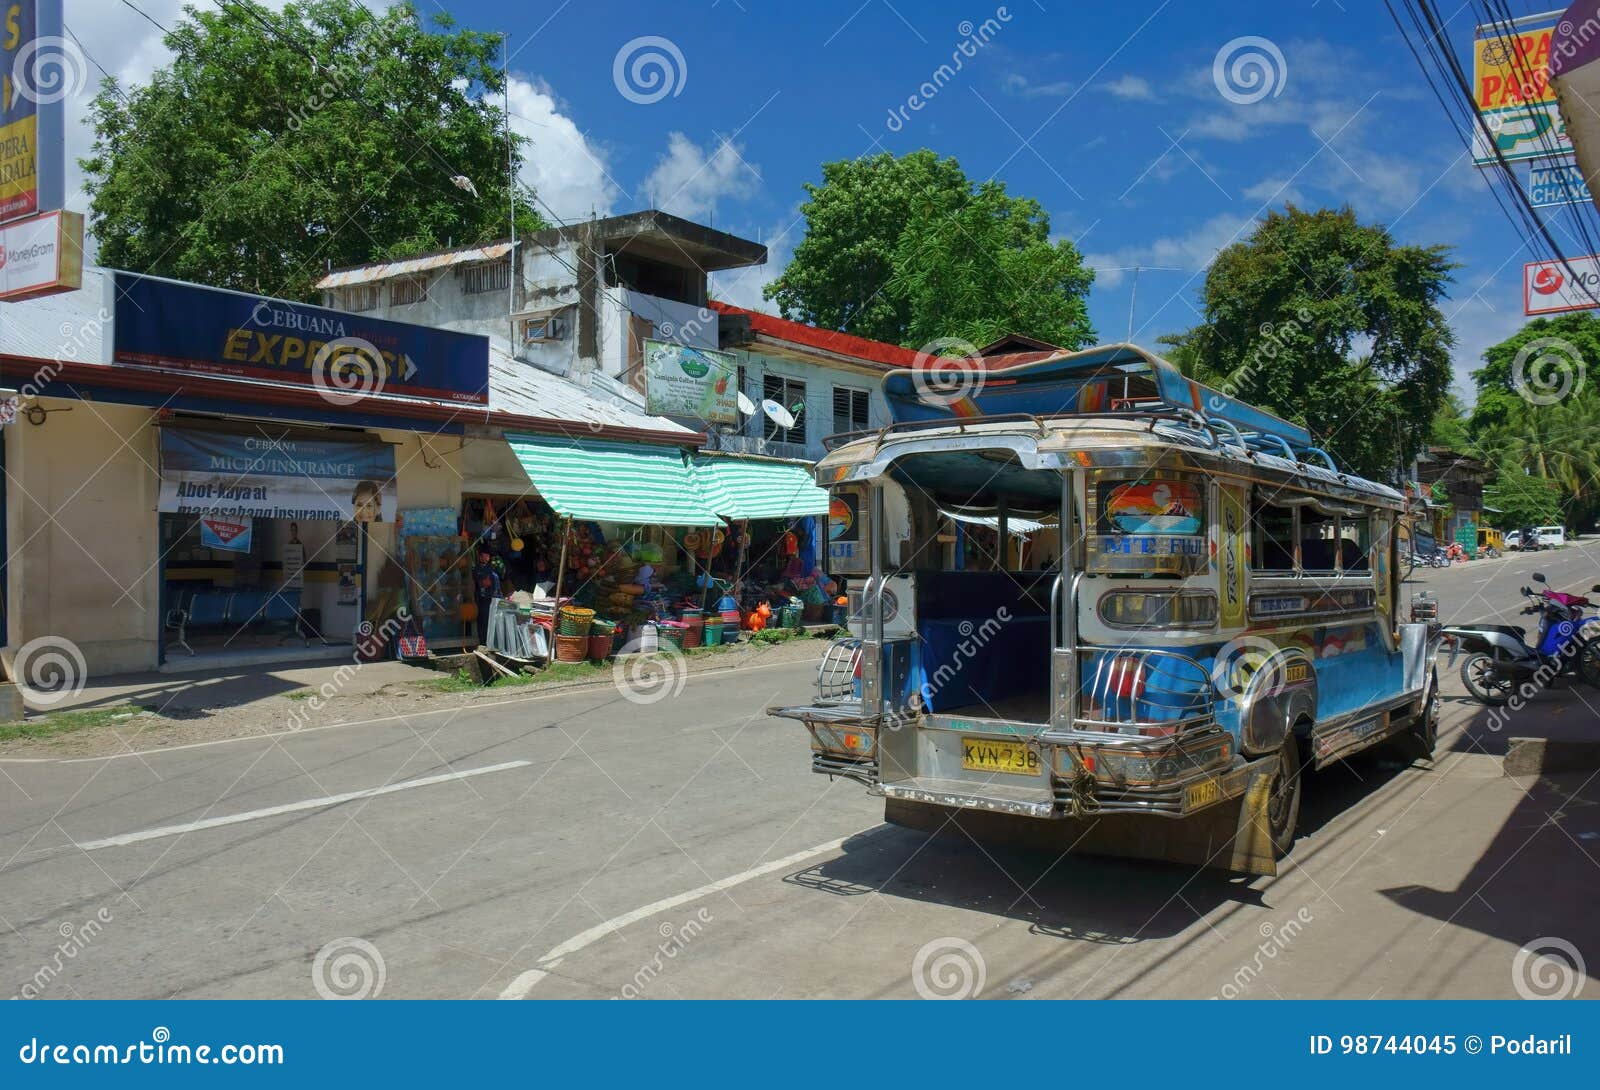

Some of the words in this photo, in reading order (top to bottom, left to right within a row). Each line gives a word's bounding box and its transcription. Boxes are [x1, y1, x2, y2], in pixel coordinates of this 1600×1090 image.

[253, 302, 346, 338] CEBUANA
[222, 328, 397, 379] EXPRESS
[210, 455, 356, 477] MICRO/INSURANCE
[273, 505, 341, 521] insurance
[965, 745, 998, 765] KVN
[1002, 748, 1037, 768] 738
